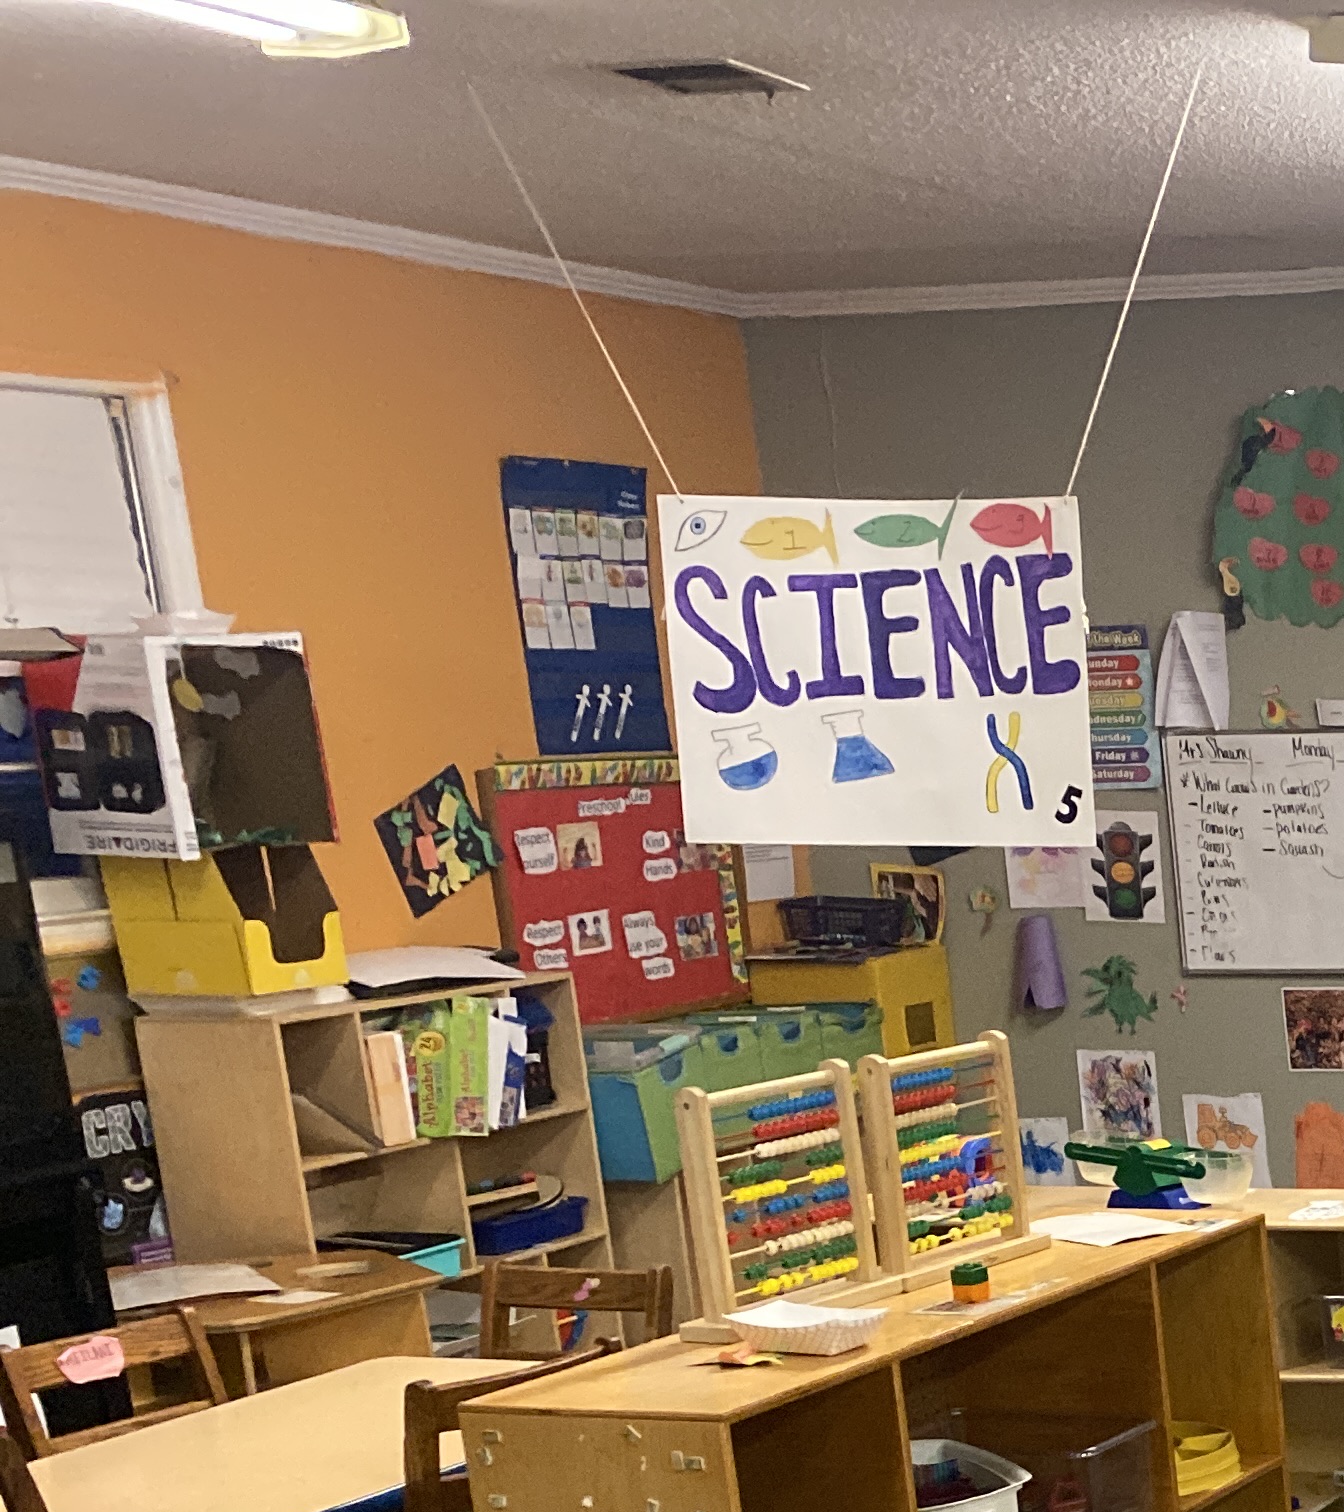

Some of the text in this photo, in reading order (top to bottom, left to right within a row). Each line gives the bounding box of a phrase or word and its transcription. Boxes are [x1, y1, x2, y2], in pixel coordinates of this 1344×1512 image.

[673, 552, 1081, 715] SCIENCE
[1088, 656, 1119, 670] unday
[1089, 674, 1123, 688] onday
[1090, 693, 1125, 706] uesday
[1090, 711, 1136, 725] dnesday
[1091, 730, 1131, 744] hursday
[1095, 751, 1127, 763] Friday
[1055, 785, 1083, 825] 5
[84, 835, 178, 853] FRIGIDAIRE
[417, 1059, 439, 1128] Alphabet
